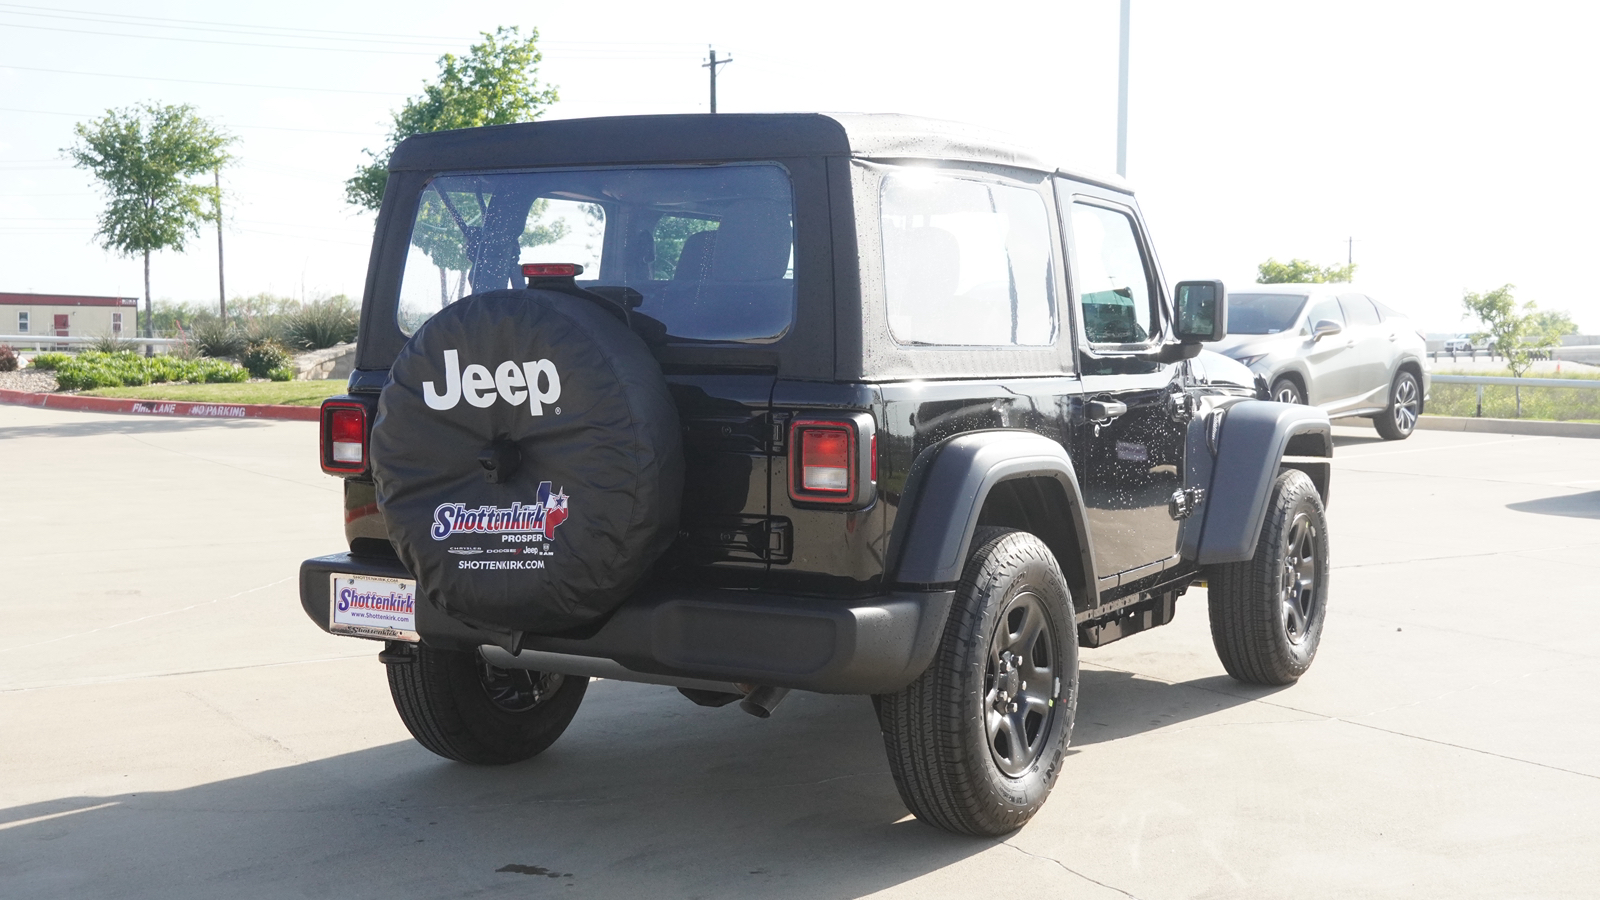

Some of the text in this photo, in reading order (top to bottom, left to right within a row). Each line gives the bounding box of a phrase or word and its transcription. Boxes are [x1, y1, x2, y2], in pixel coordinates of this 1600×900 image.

[422, 349, 562, 416] Jeep
[152, 403, 176, 414] LANE
[191, 405, 246, 417] NO PARKING
[431, 502, 549, 540] Shottenkirk
[501, 534, 543, 542] PROSPER
[523, 546, 539, 555] Jeep
[458, 560, 545, 570] SHOTTENKIRK.COM
[338, 587, 415, 614] Shottenkirk
[351, 611, 410, 623] www.Shottenkirk.com
